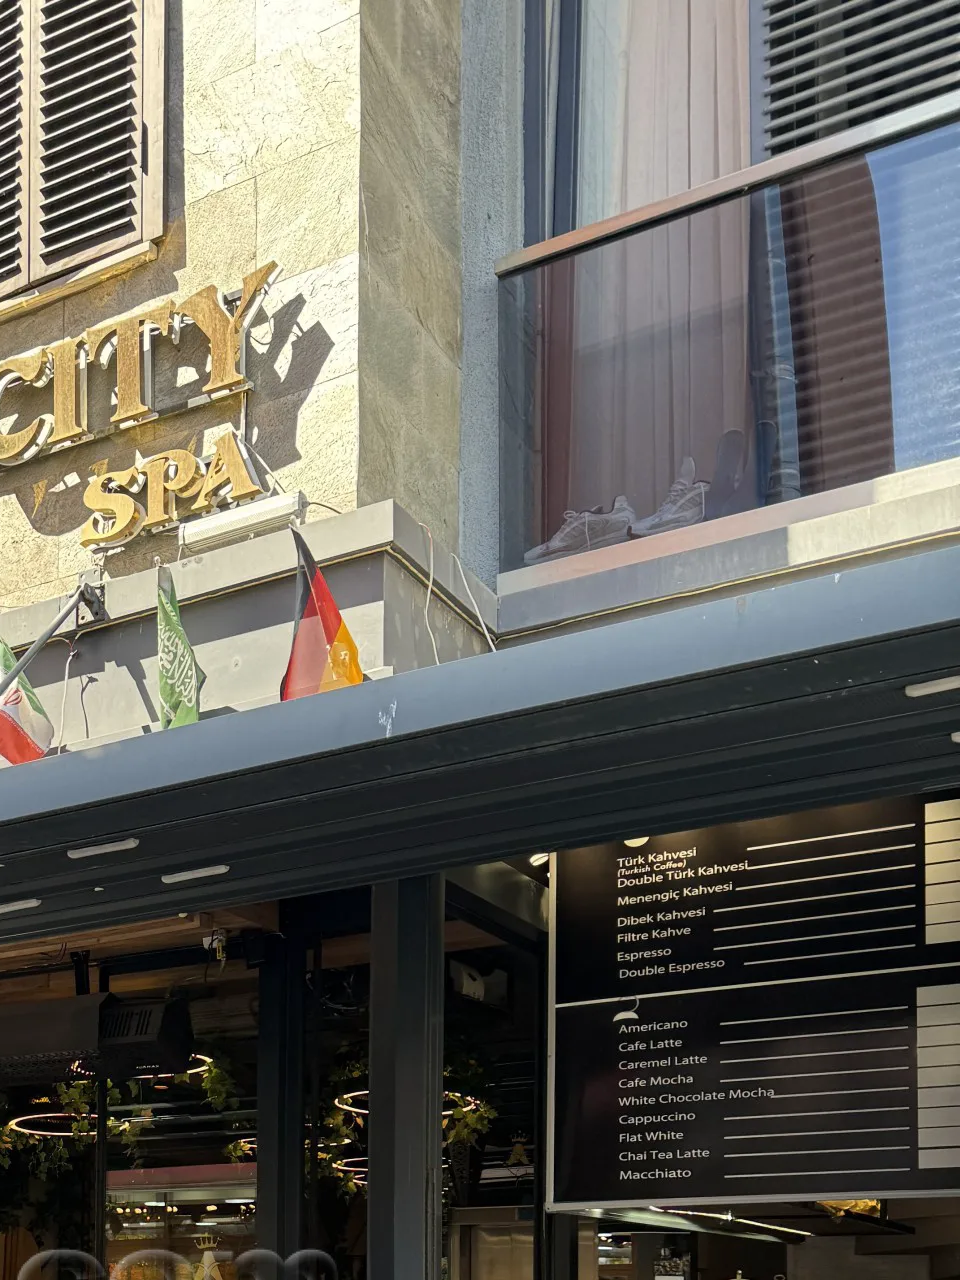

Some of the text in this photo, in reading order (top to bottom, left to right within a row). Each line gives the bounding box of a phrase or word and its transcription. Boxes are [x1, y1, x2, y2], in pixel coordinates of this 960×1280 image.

[79, 422, 263, 549] SPA
[617, 847, 696, 868] Türk Kahvesi
[618, 859, 686, 877] (Turkish Coffee)
[618, 860, 749, 888] Double Türk Kahvesi
[617, 882, 732, 906] Menengiç Kahvesi
[617, 907, 706, 927] Dibek Kahvesi
[617, 927, 691, 943] Filtre Kahve
[617, 948, 672, 962] Espresso
[619, 960, 725, 978] Double Espresso
[619, 1020, 688, 1034] Americano
[619, 1038, 683, 1052] Cafe Latte
[618, 1055, 708, 1070] Caremel Latte
[618, 1075, 694, 1088] Cafe Mocha
[618, 1087, 775, 1106] White Chocolate Mocha
[619, 1112, 695, 1126] Cappuccino
[619, 1131, 684, 1143] Flat White
[619, 1149, 710, 1161] Chai Tea Latte
[619, 1169, 691, 1180] Macchiato
